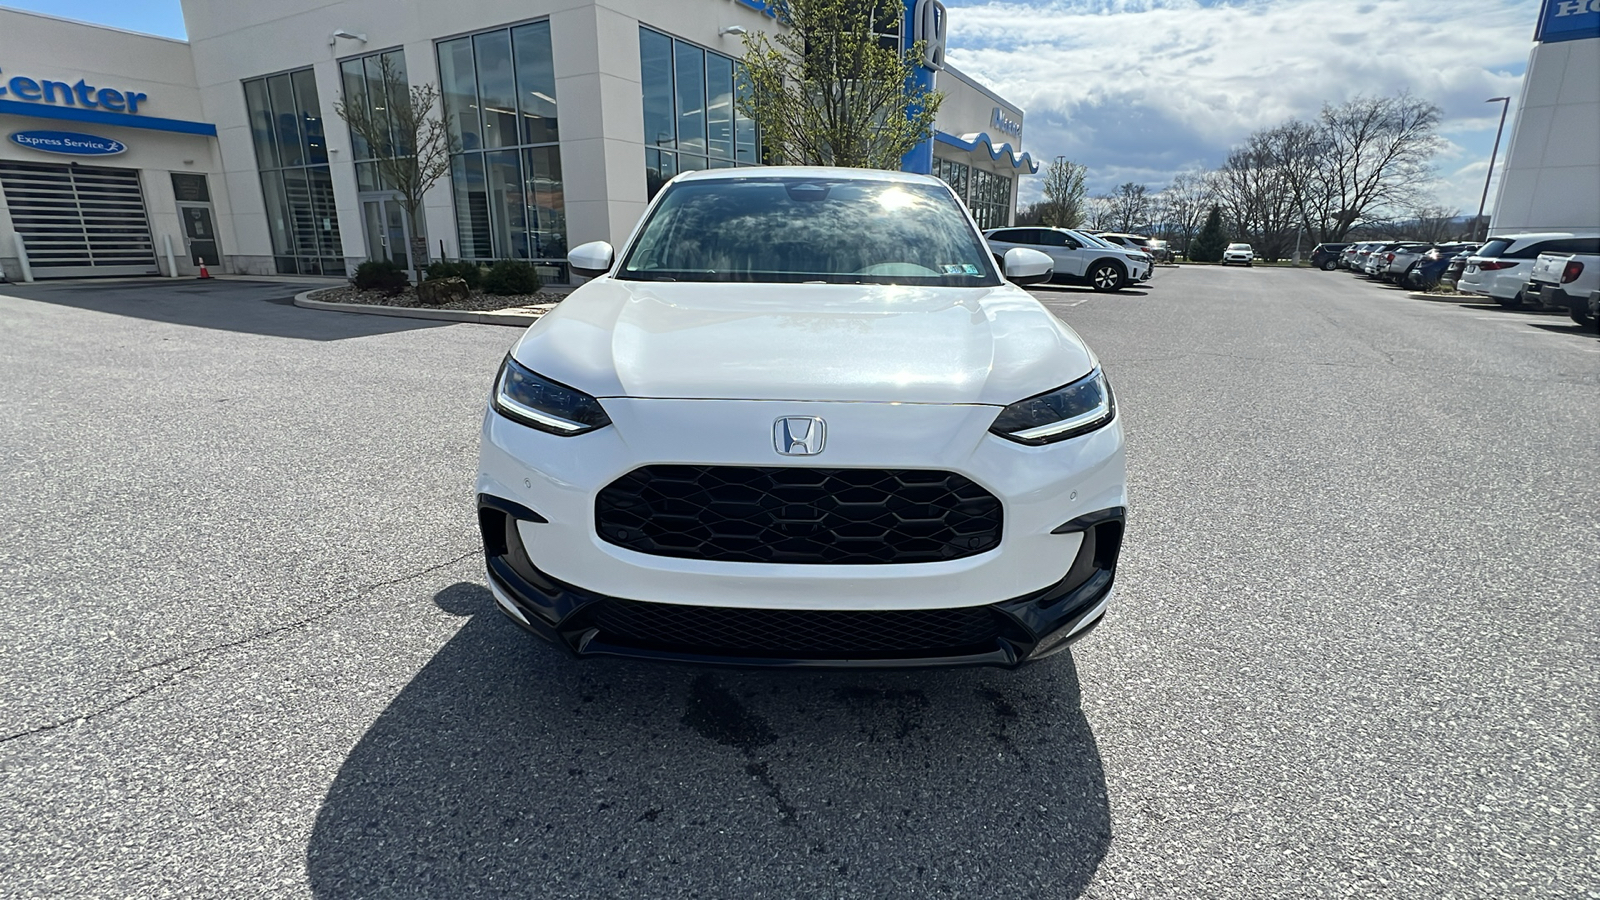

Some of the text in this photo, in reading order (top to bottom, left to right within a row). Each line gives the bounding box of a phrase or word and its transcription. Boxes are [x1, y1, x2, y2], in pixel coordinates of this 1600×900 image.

[0, 66, 147, 113] enter
[16, 134, 105, 149] Express Service
